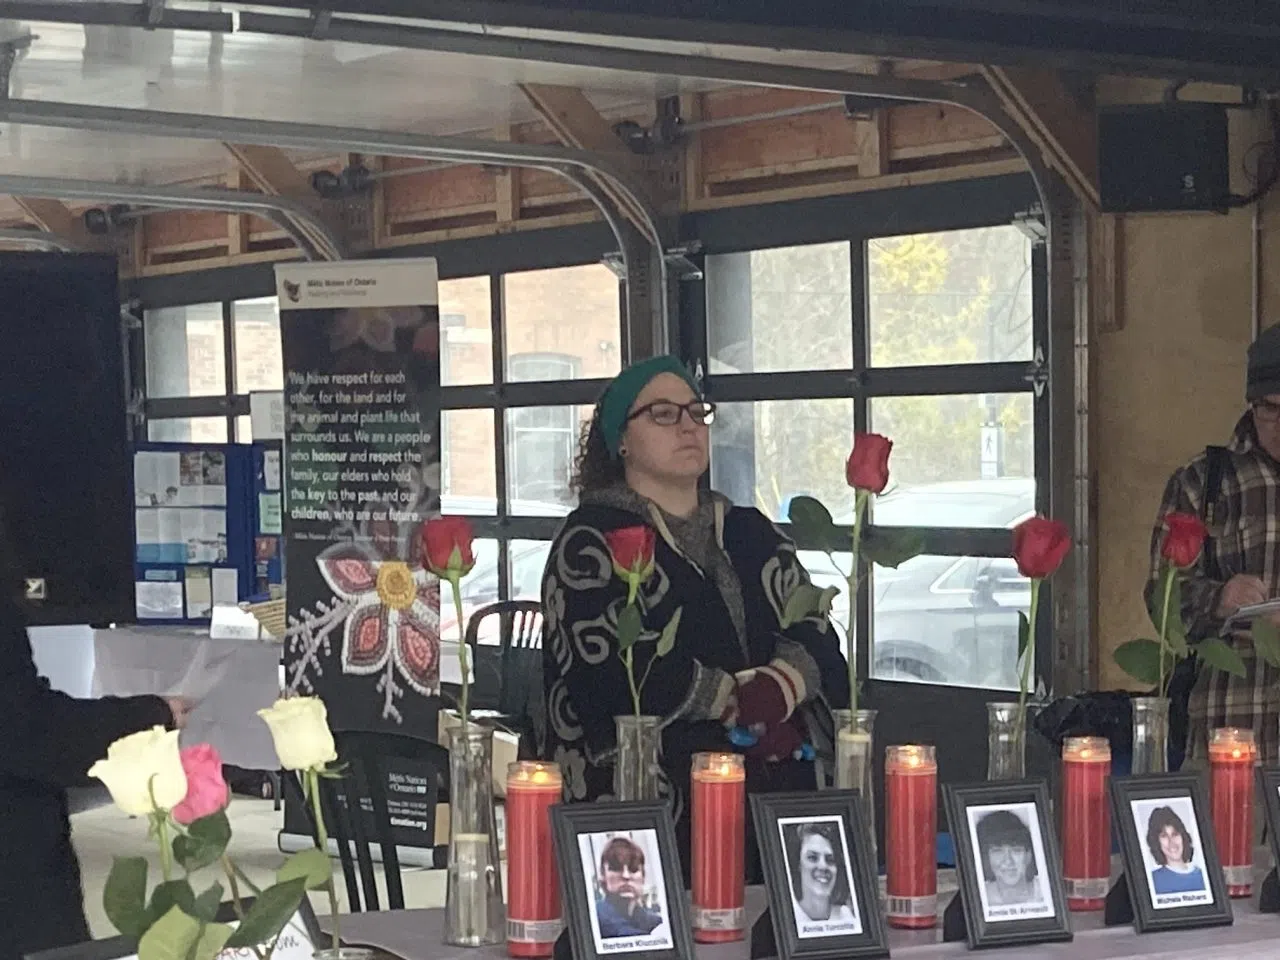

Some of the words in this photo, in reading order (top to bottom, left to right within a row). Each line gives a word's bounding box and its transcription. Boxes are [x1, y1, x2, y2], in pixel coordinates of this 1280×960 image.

[307, 371, 329, 384] have
[332, 372, 368, 387] respect
[370, 370, 383, 384] for
[385, 371, 405, 384] each
[319, 390, 333, 403] for
[336, 391, 351, 404] the
[353, 391, 374, 403] land
[375, 391, 391, 403] and
[393, 390, 406, 403] for
[340, 411, 358, 423] and
[360, 410, 382, 426] plant
[400, 410, 420, 423] that
[291, 430, 336, 443] surrounds
[354, 430, 369, 443] We
[371, 433, 385, 443] are
[394, 430, 431, 447] people
[291, 449, 309, 461] who
[311, 448, 347, 462] honour
[350, 449, 367, 462] and
[369, 450, 402, 465] respect
[404, 449, 421, 462] the
[322, 470, 338, 481] our
[341, 467, 369, 481] elders
[371, 468, 389, 481] who
[391, 467, 411, 481] hold
[291, 487, 305, 501] the
[307, 487, 325, 505] key
[328, 488, 338, 501] to
[340, 488, 356, 501] the
[382, 488, 398, 501] and
[291, 506, 333, 521] children,
[334, 507, 353, 520] who
[356, 509, 370, 520] are
[373, 510, 387, 521] our
